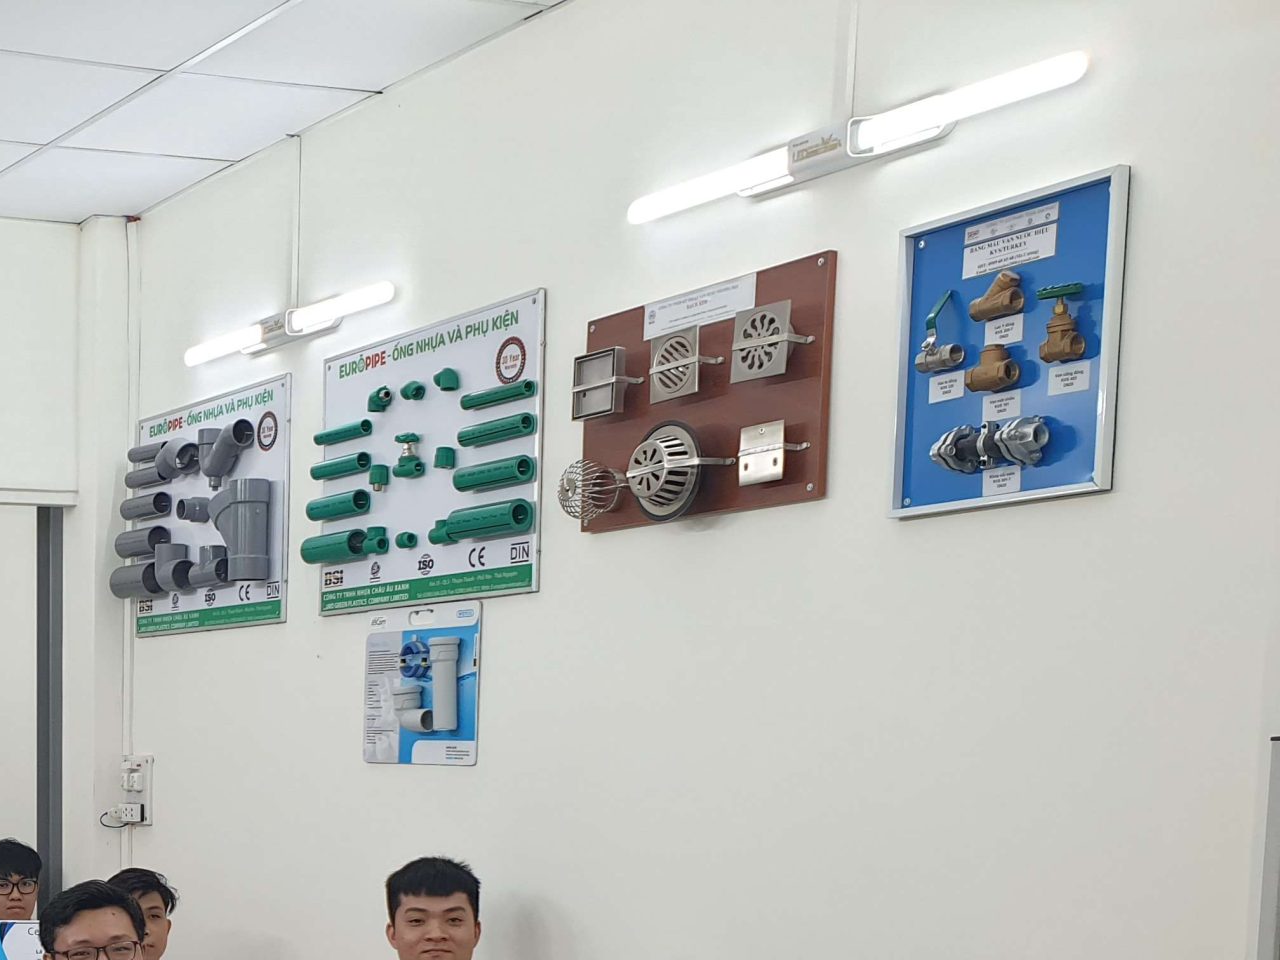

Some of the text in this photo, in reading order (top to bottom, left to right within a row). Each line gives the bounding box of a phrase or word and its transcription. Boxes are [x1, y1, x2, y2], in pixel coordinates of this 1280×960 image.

[392, 341, 414, 361] ỐNG
[416, 332, 446, 354] NHỰA
[447, 324, 463, 344] VÀ
[465, 321, 489, 340] PHỤ
[491, 310, 519, 331] KIỆN
[417, 558, 434, 571] ISO
[510, 545, 530, 561] DIN
